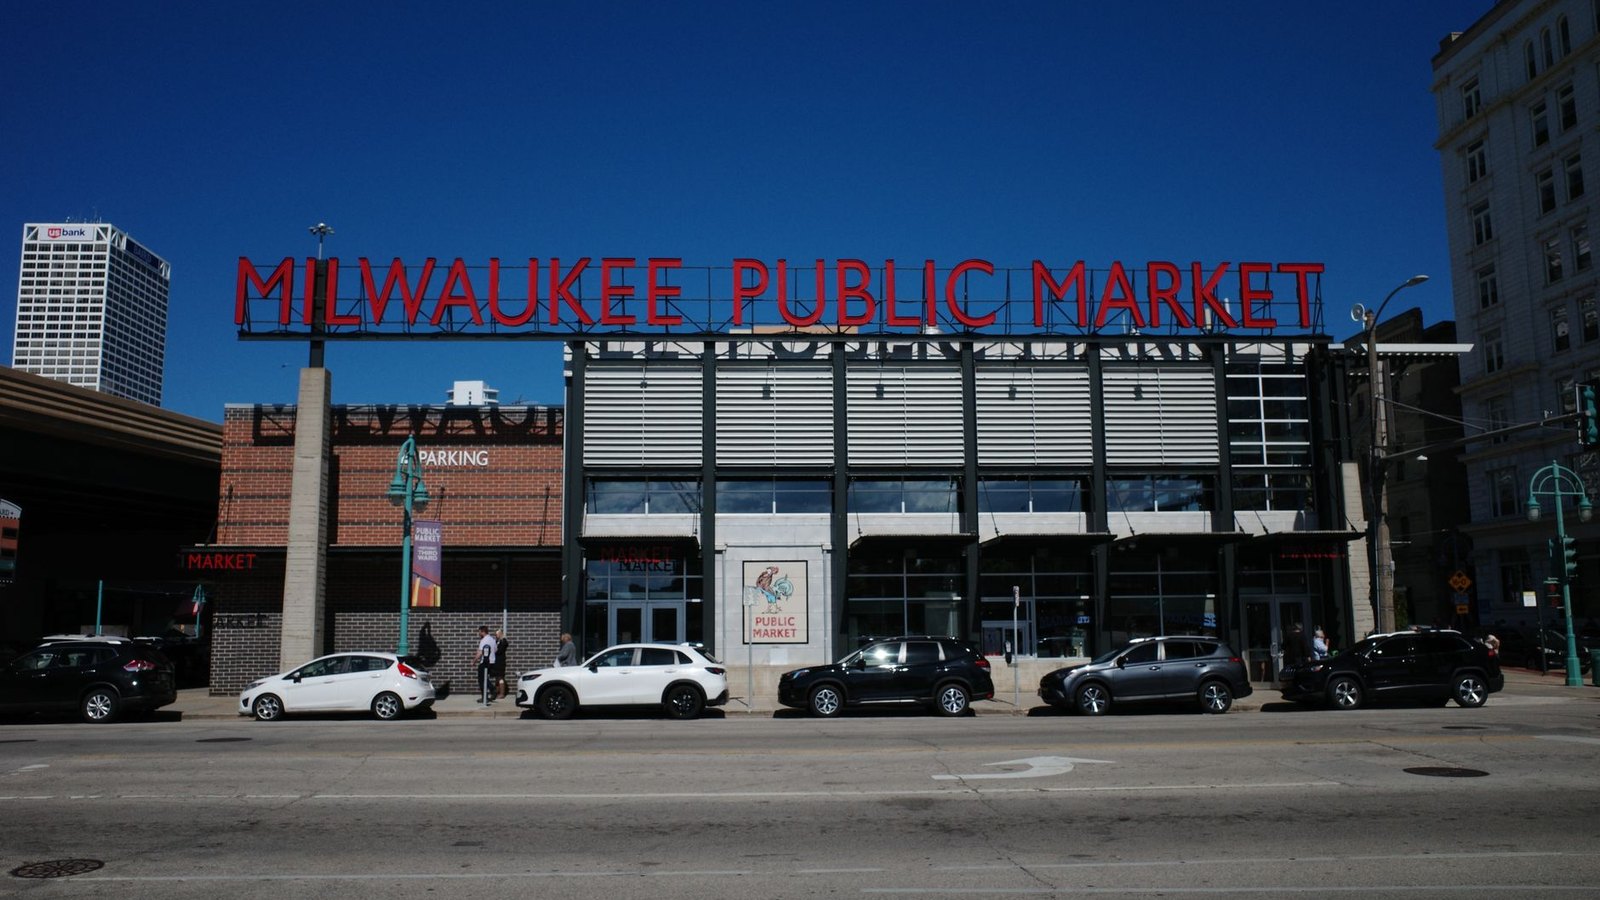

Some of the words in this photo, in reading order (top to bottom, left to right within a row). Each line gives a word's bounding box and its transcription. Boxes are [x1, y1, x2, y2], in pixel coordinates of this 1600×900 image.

[62, 228, 85, 237] bank
[234, 256, 682, 326] MILWAUKEE
[733, 258, 996, 327] PUBLIC
[1032, 260, 1325, 329] MARKET
[419, 450, 489, 467] PARKING
[416, 527, 440, 535] PUBLIC
[415, 534, 441, 543] MARKET
[598, 545, 673, 564] MARKET
[187, 553, 256, 570] MARKET
[755, 616, 795, 626] PUBLIC
[752, 629, 797, 638] MARKET
